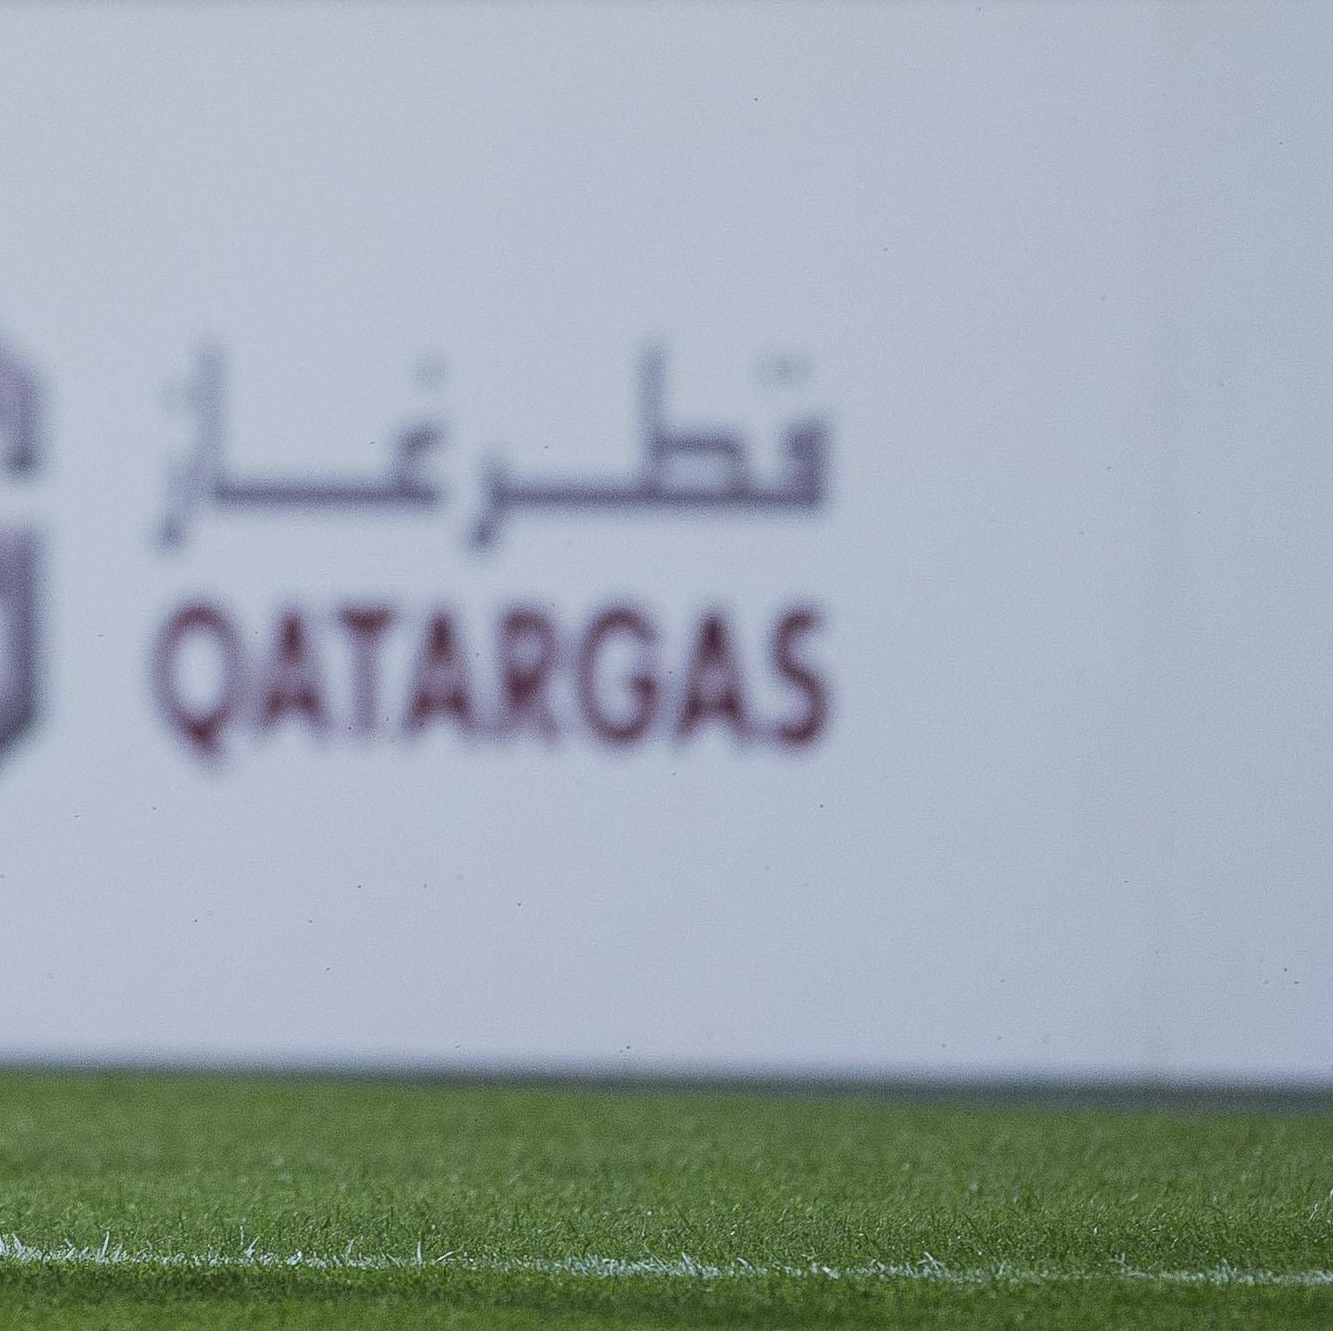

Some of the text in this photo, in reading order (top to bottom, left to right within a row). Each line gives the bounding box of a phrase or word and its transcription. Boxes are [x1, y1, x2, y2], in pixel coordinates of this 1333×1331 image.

[155, 343, 831, 551] قطر غاز
[151, 599, 831, 757] QATARGAS
